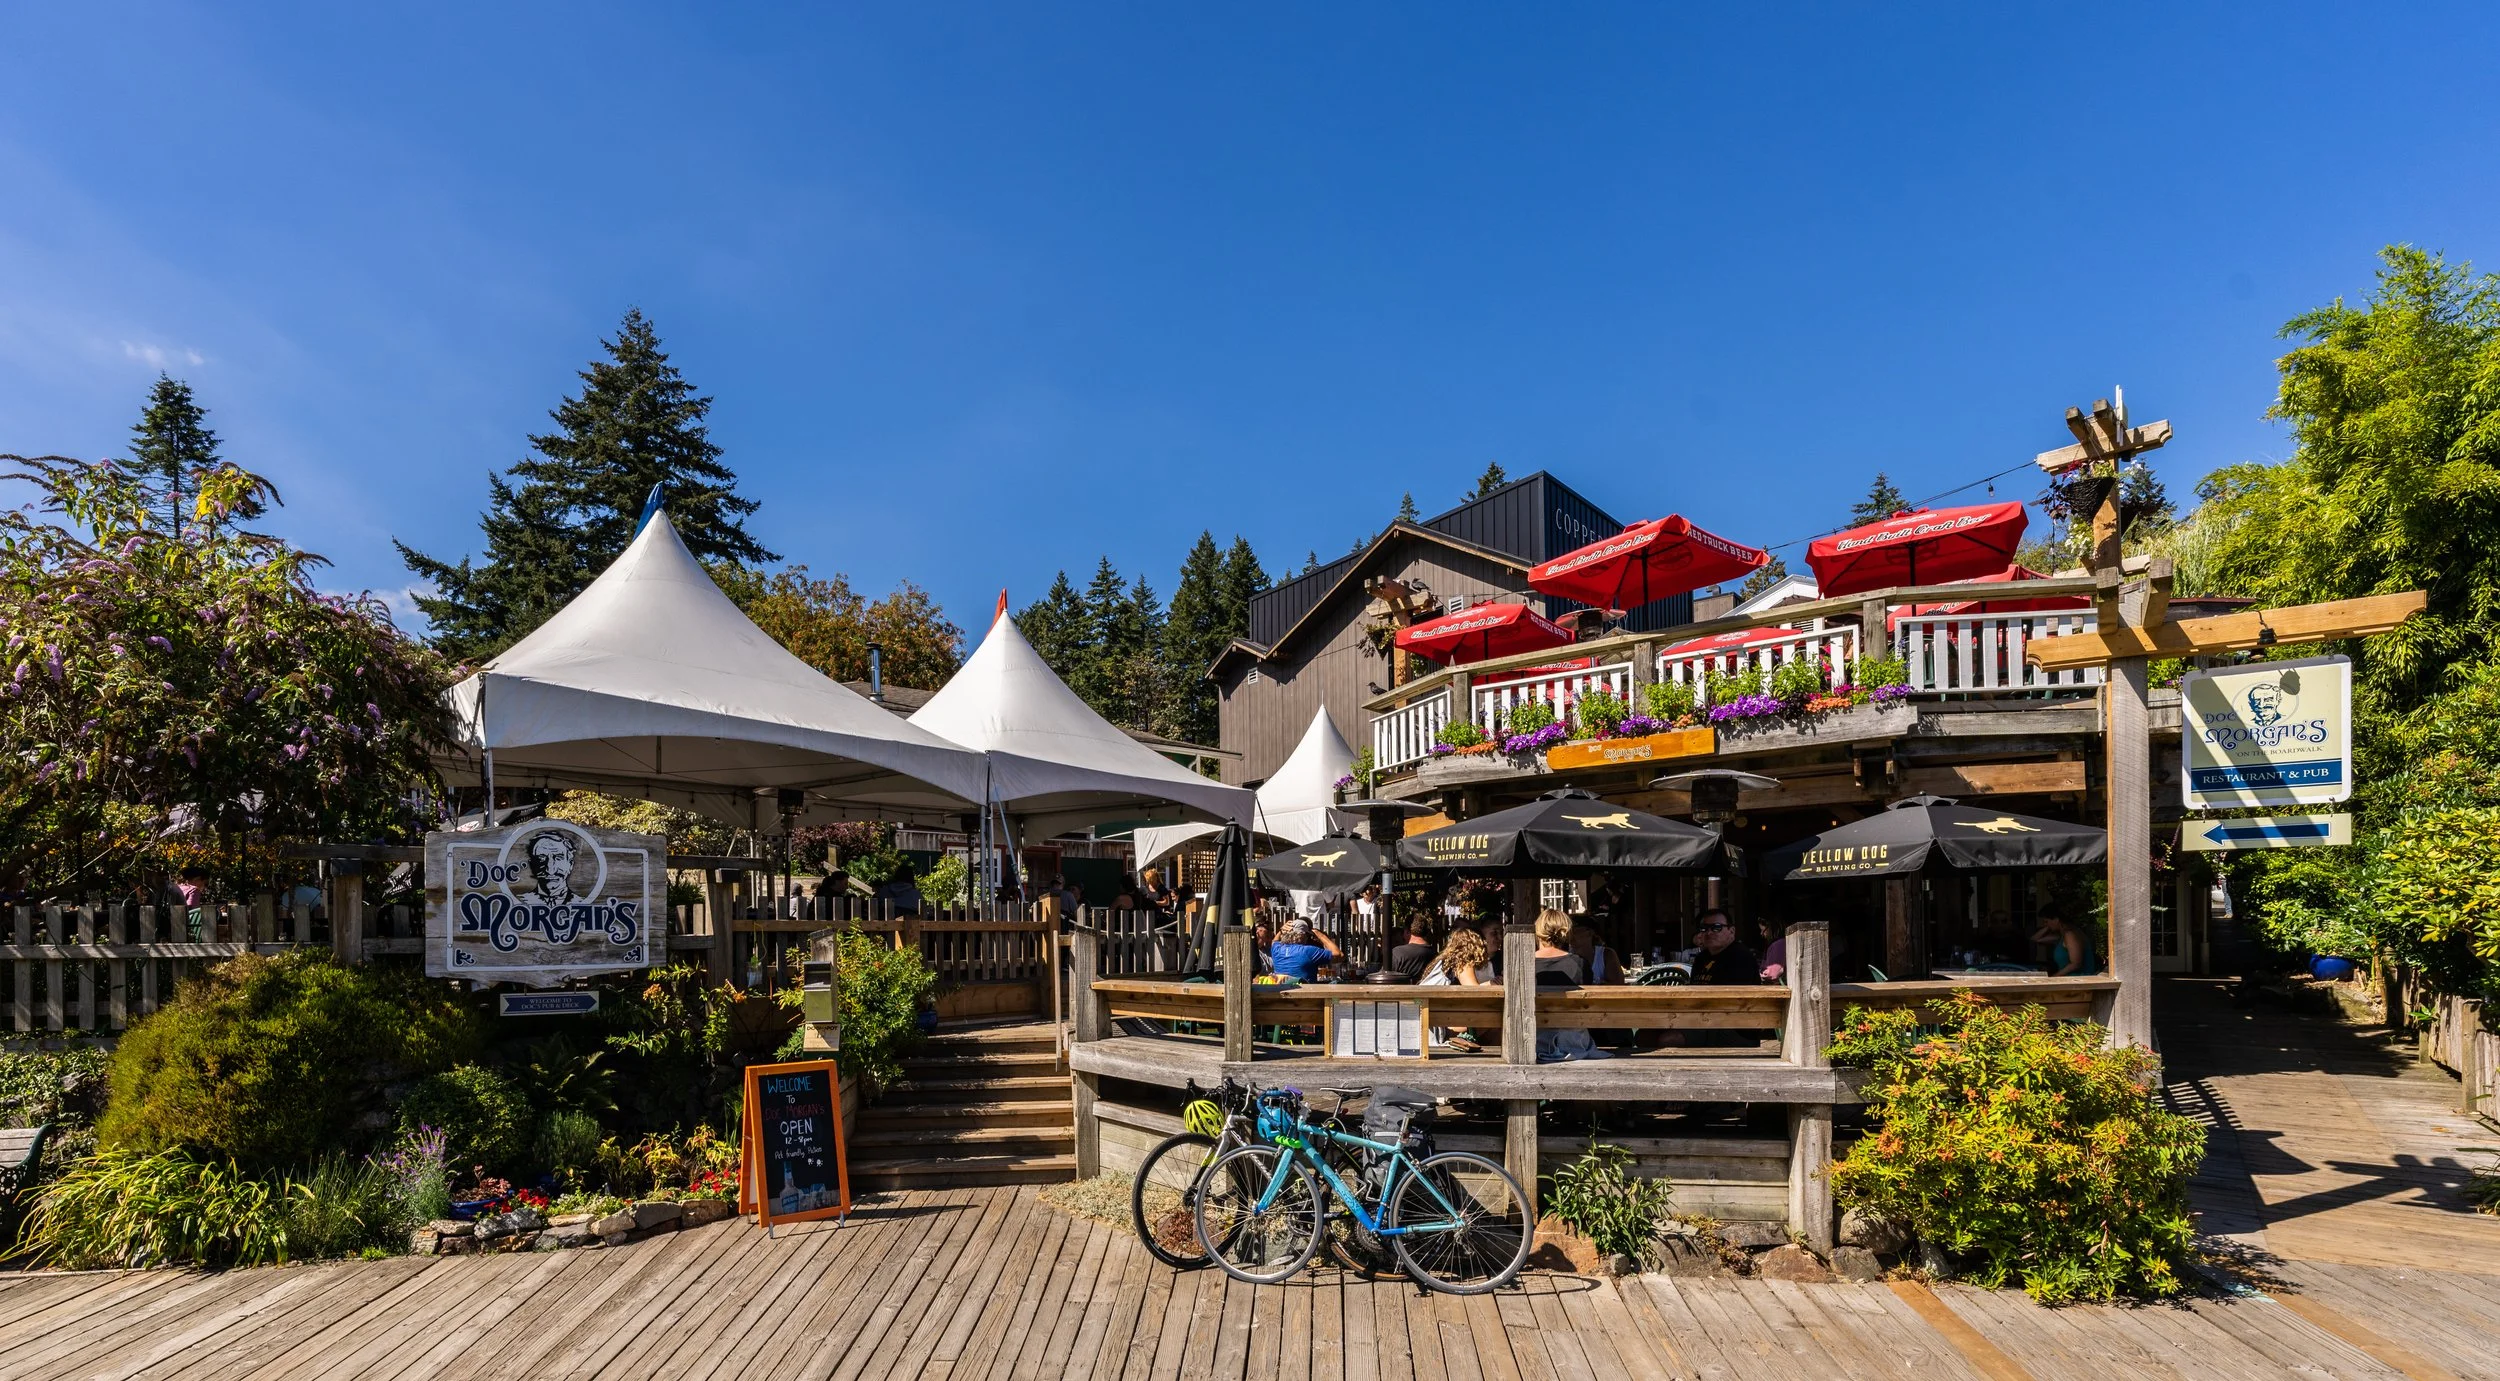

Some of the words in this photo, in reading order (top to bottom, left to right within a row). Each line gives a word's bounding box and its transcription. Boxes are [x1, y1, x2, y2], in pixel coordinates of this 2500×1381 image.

[1835, 535, 1874, 552] Hand
[1875, 527, 1912, 543] Built
[1914, 519, 1955, 536] Craft
[1955, 513, 1992, 529] Beer
[1687, 527, 1702, 543] RED
[1702, 534, 1730, 553] TRUCK
[1730, 544, 1754, 562] BEER
[1545, 557, 1574, 577] Hand
[1573, 551, 1601, 567] Built
[1602, 540, 1631, 557] Craft
[1631, 532, 1657, 547] Beer
[1410, 630, 1435, 639] Hand
[1436, 624, 1459, 635] Built
[1459, 618, 1486, 631] Craft
[2203, 771, 2285, 784] RESTAURANT
[2288, 770, 2300, 779] &
[2303, 768, 2329, 777] PUB
[1427, 836, 1466, 852] YELLOW
[1469, 834, 1489, 849] DOG
[1438, 853, 1466, 861] BREWING
[1801, 847, 1854, 865] YELLOW
[1860, 844, 1888, 860] DOG
[1816, 864, 1856, 873] BREWING
[1859, 862, 1873, 870] CO.
[767, 1075, 814, 1094] WELCOME
[780, 1117, 813, 1136] OPEN
